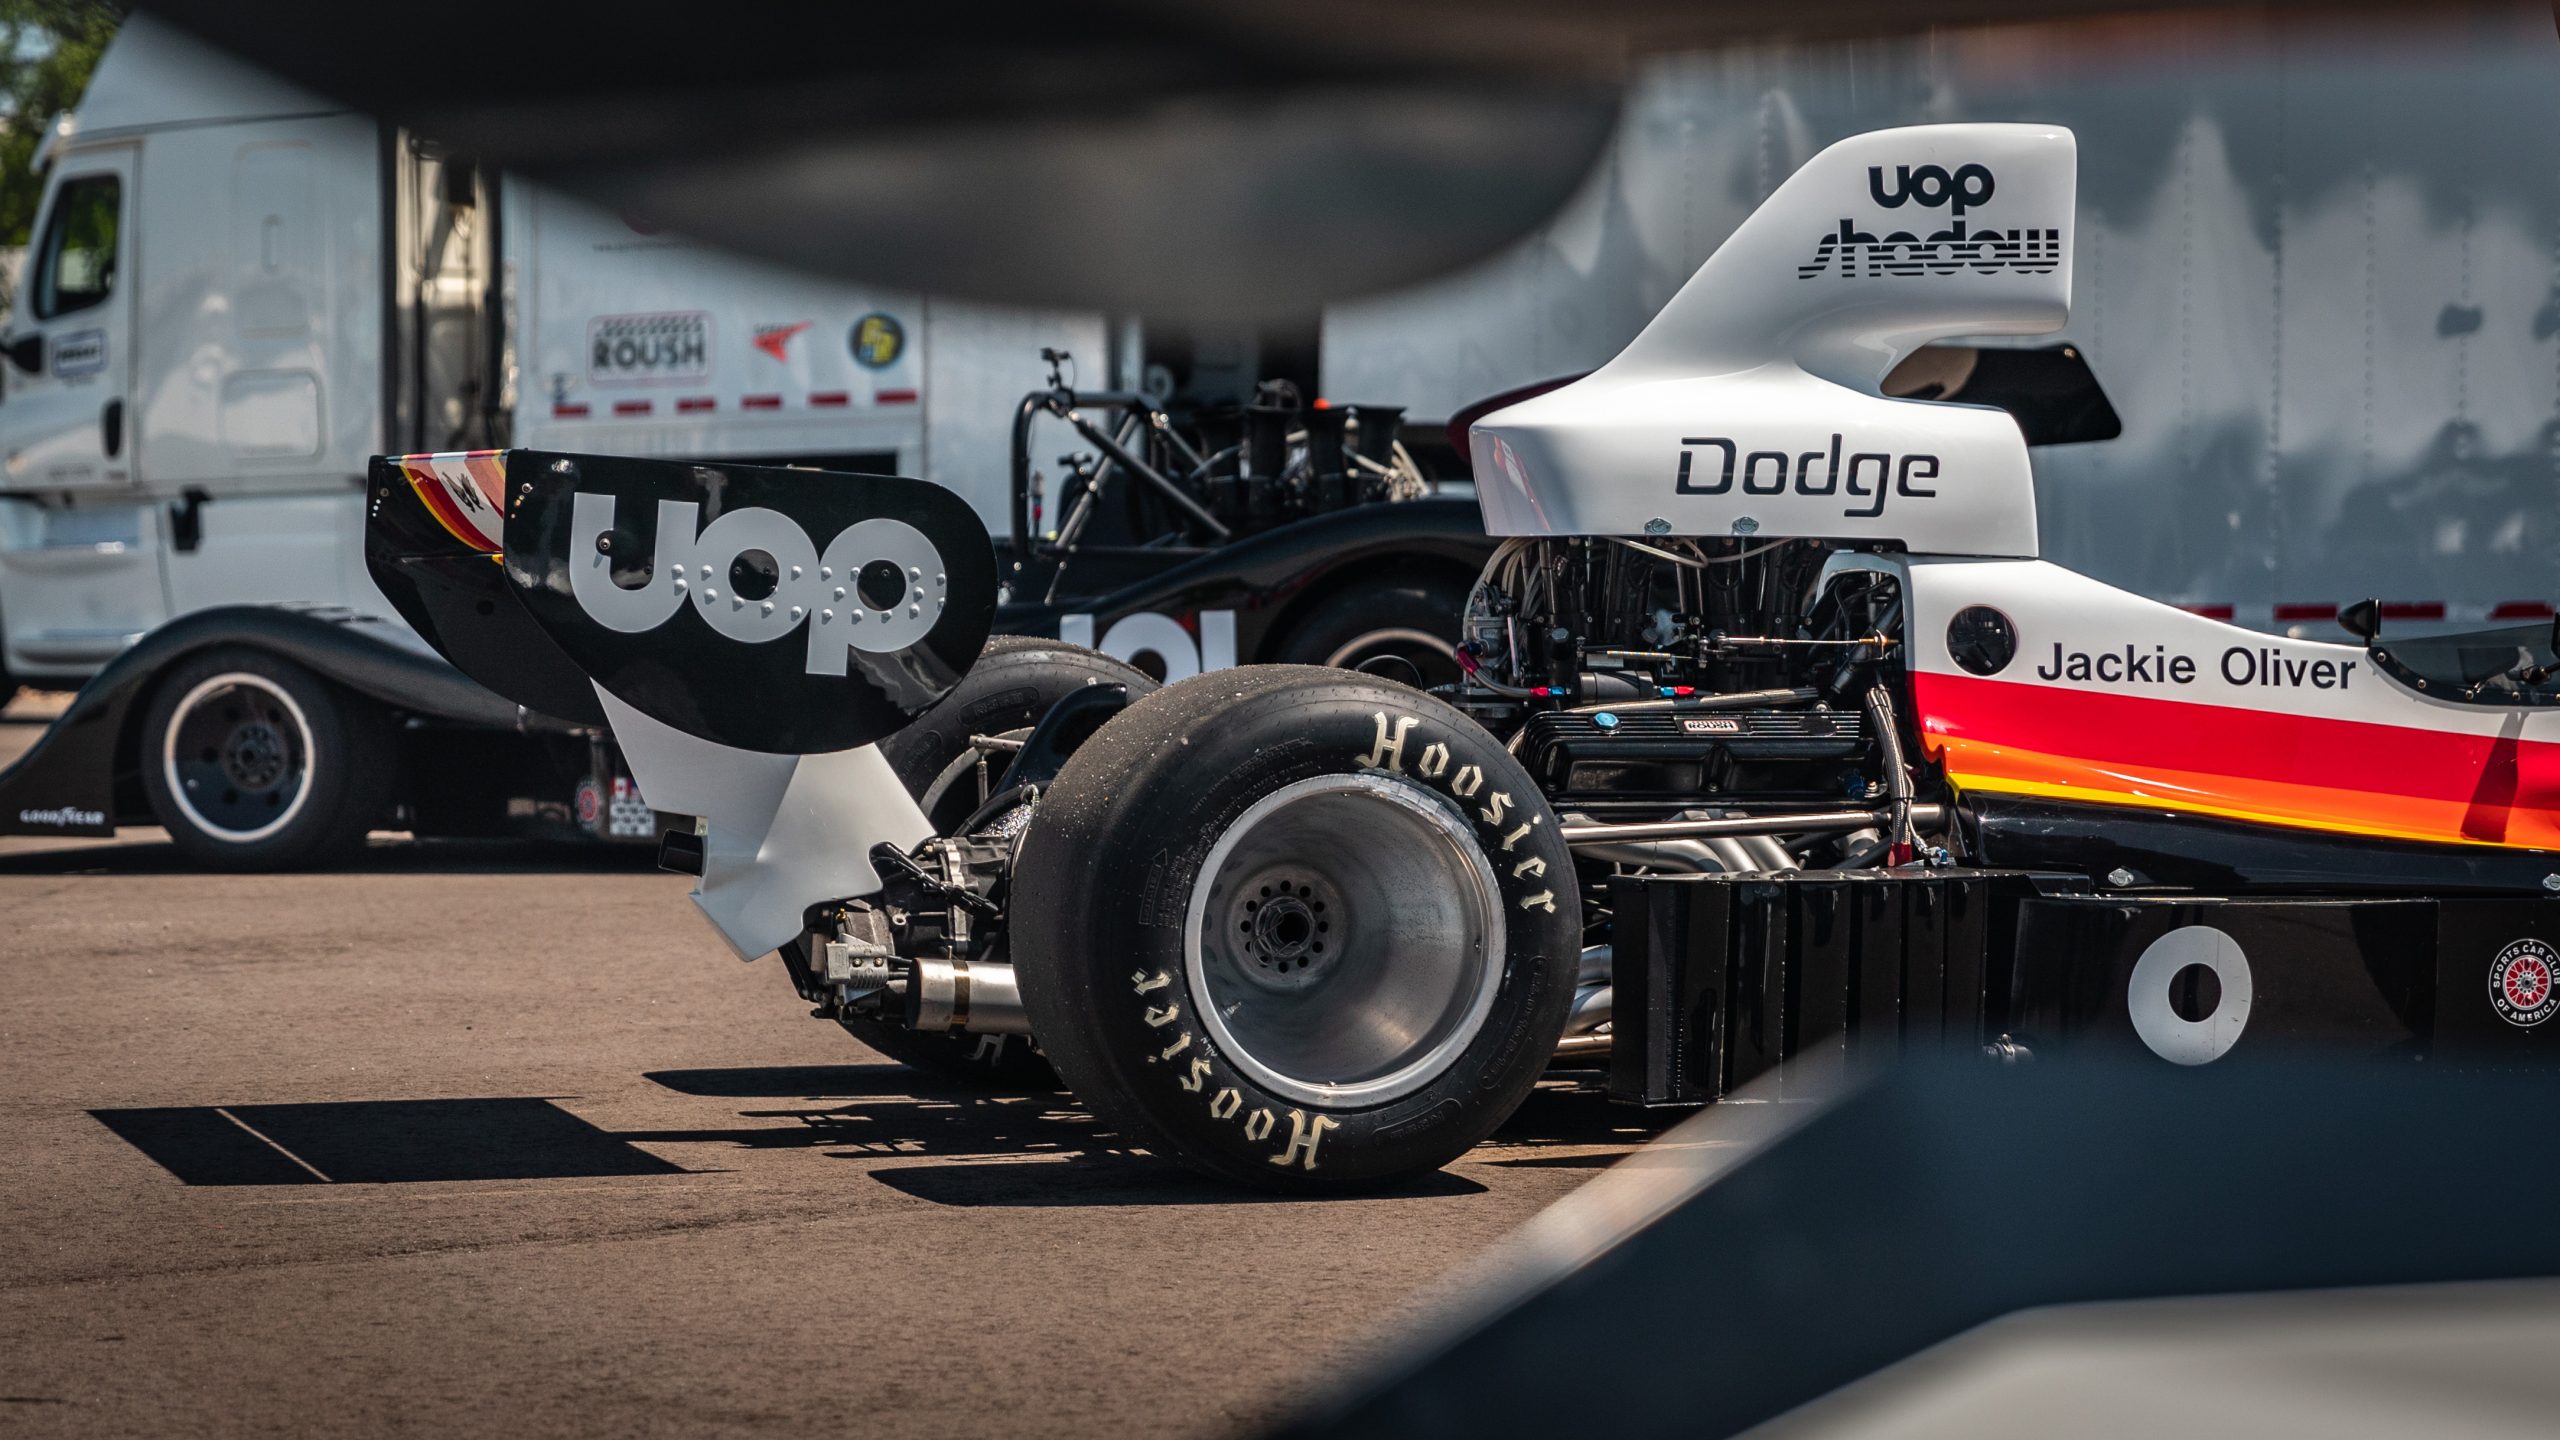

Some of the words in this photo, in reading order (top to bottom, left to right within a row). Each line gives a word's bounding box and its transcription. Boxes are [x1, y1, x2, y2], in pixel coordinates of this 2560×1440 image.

[1798, 218, 2059, 279] shadow
[592, 335, 706, 370] ROUSH
[1675, 433, 1939, 517] Dodge
[2037, 643, 2196, 684] Jackie
[2221, 647, 2356, 689] Oliver
[1353, 711, 1556, 913] Hoosier
[2493, 947, 2520, 988] SPORTS
[2522, 944, 2545, 956] CAR
[2546, 954, 2560, 985] CLUB
[2497, 999, 2510, 1012] OF
[2510, 999, 2556, 1022] AMERICA
[1131, 968, 1341, 1170] Hoosier
